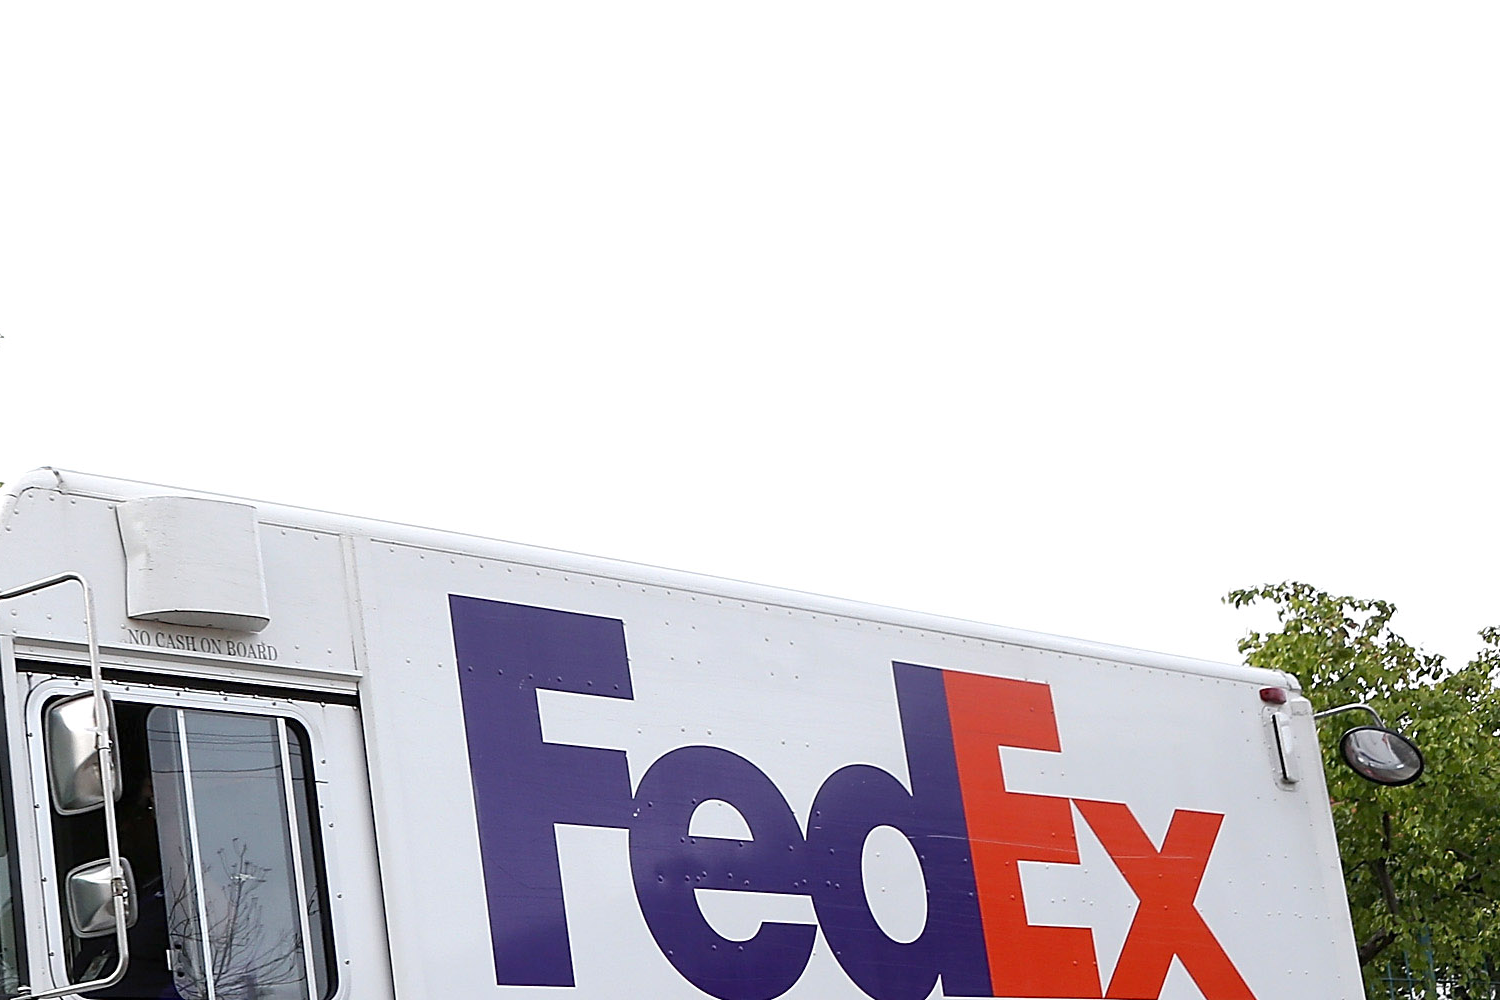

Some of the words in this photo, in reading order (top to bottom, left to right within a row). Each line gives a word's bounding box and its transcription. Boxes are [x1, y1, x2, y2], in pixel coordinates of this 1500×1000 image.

[127, 628, 151, 646] NO
[155, 631, 197, 652] CASH
[200, 637, 221, 655] ON
[225, 640, 278, 662] BOARD
